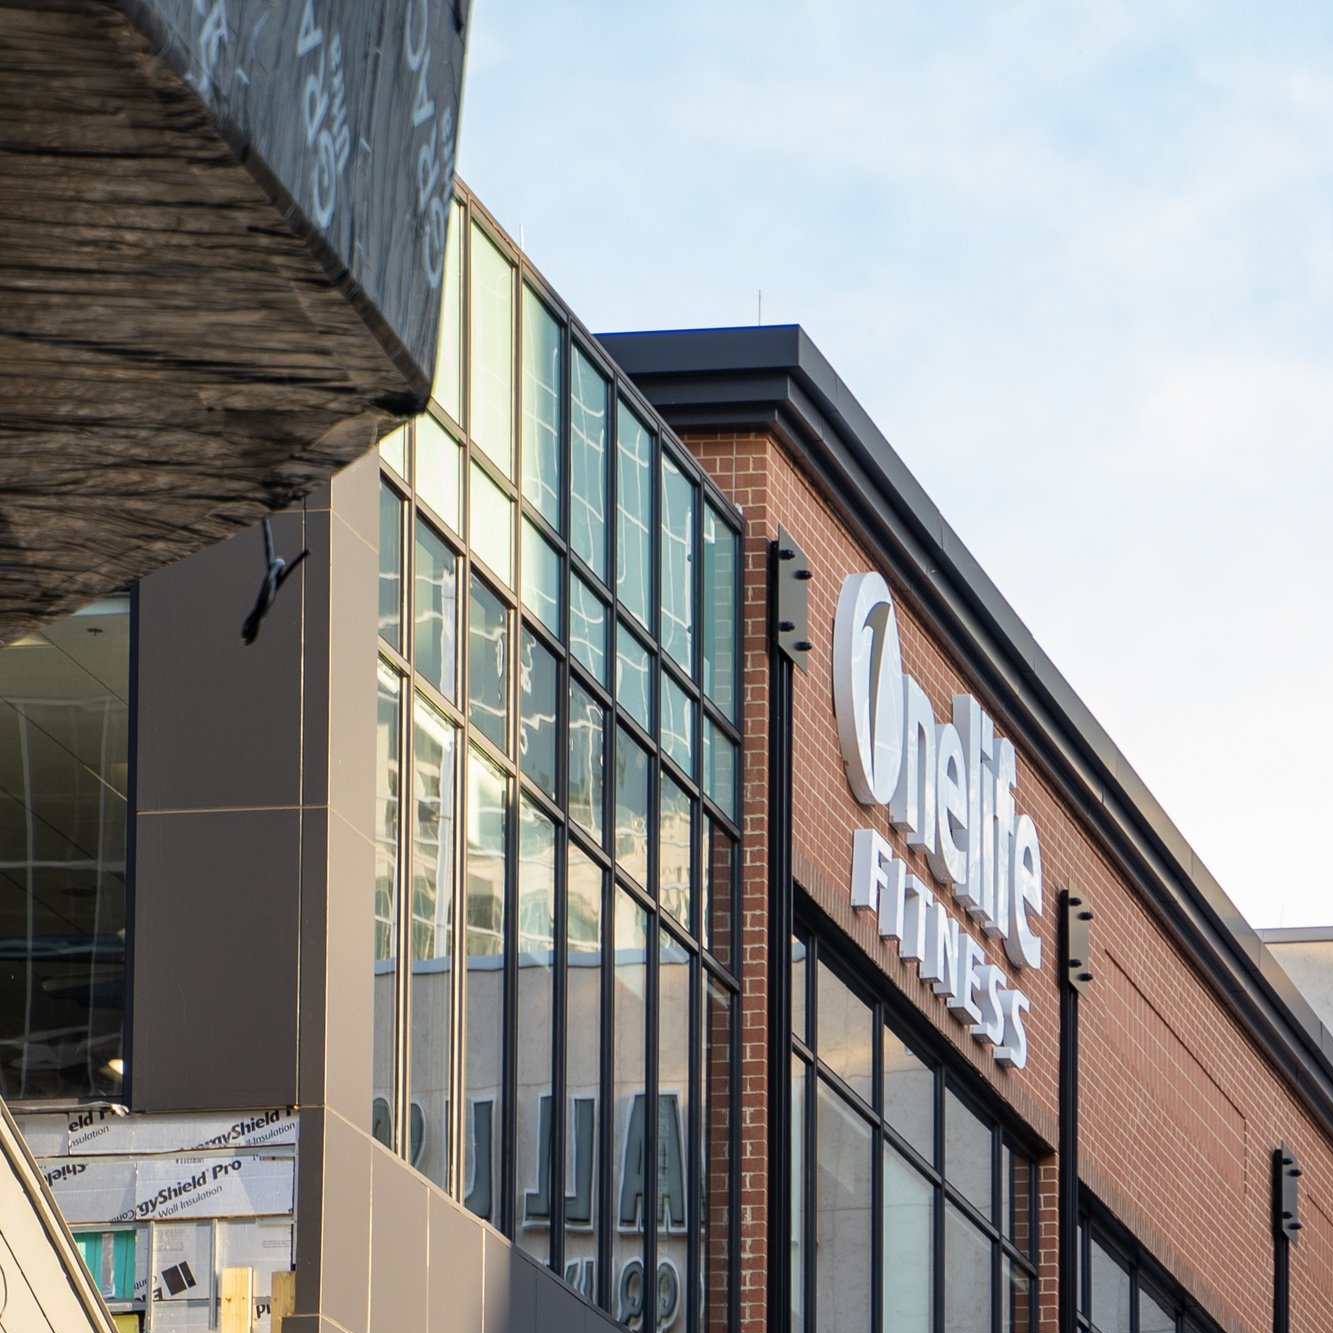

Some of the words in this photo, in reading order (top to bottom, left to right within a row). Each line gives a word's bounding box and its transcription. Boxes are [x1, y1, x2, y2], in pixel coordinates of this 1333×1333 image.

[833, 571, 1043, 970] Onelife
[851, 829, 1030, 1070] FITNESS
[180, 1185, 223, 1209] Insulation
[212, 1159, 242, 1180] Pro
